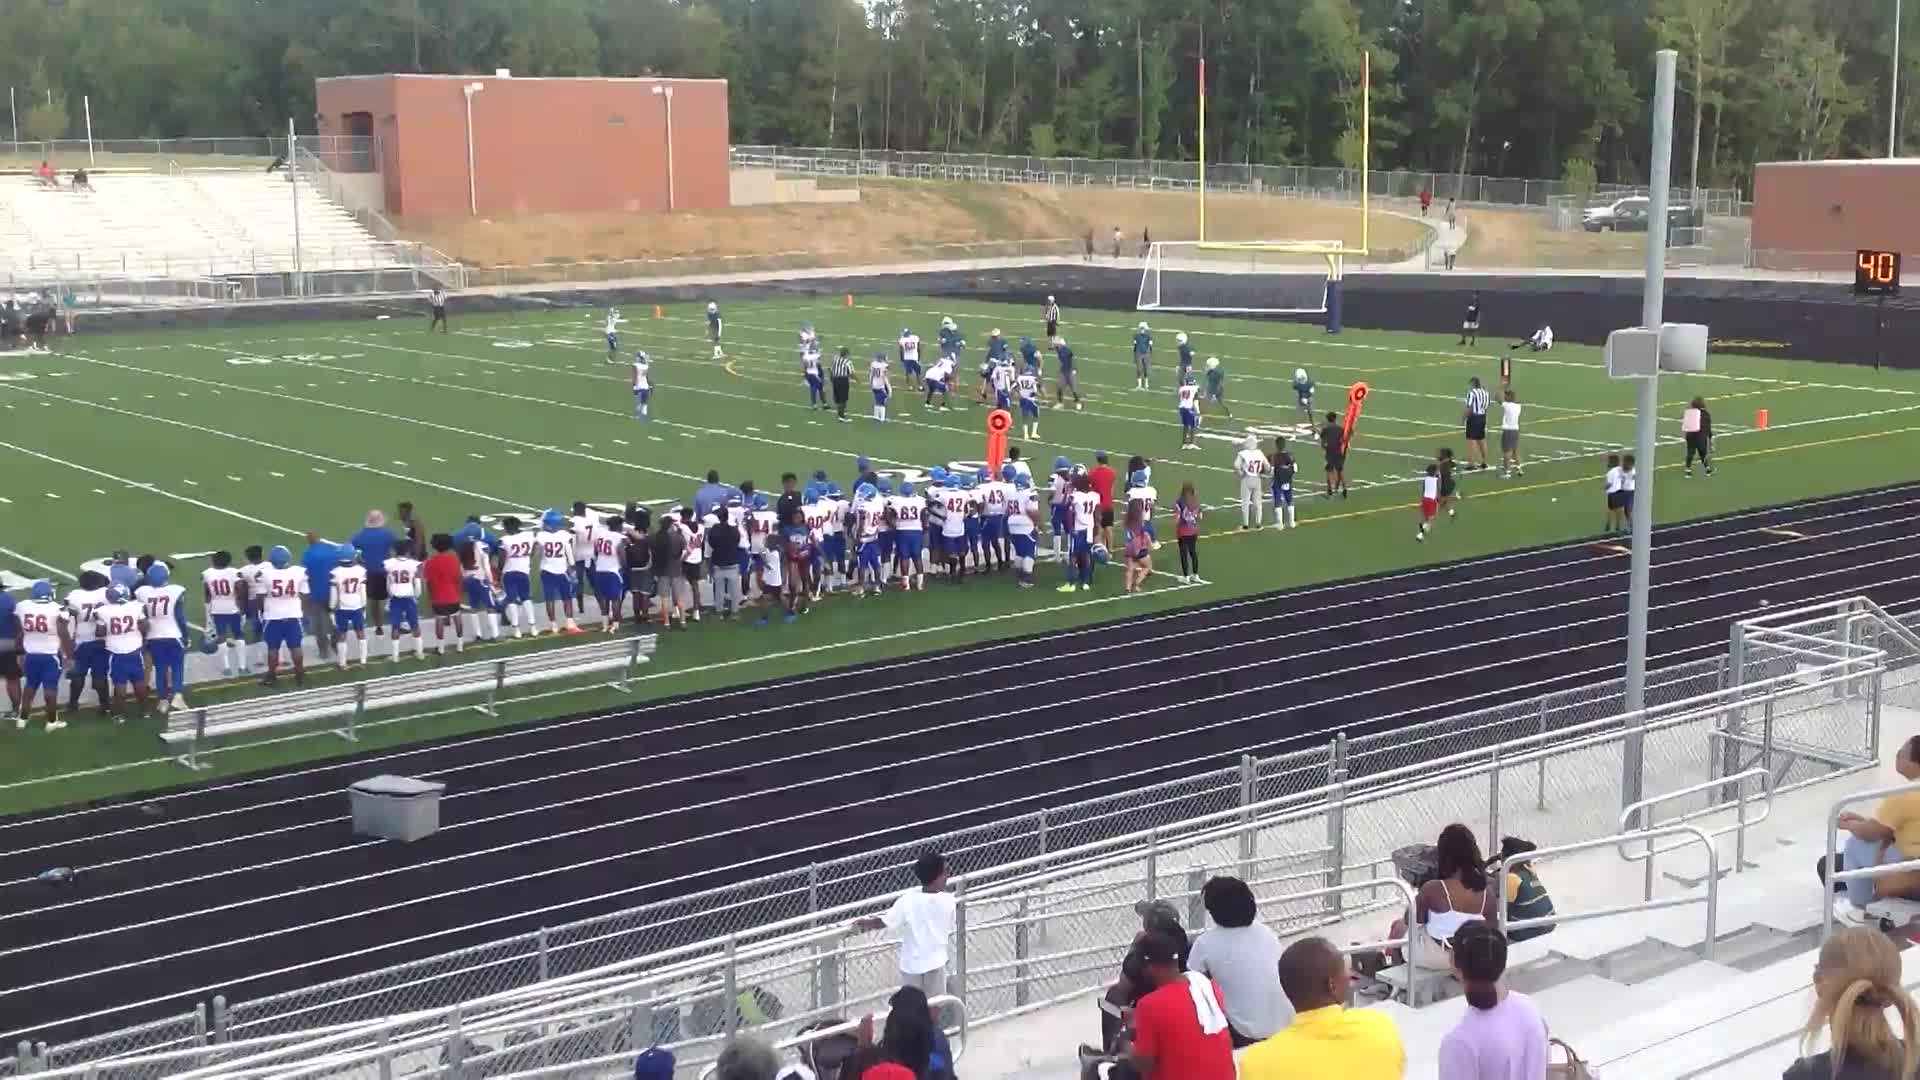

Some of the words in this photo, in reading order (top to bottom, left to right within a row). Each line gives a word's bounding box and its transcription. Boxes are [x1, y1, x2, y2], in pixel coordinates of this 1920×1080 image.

[1859, 253, 1893, 282] 40
[947, 497, 963, 512] 42
[987, 489, 1004, 504] 43
[900, 505, 918, 520] 63
[511, 541, 530, 558] 22
[342, 577, 359, 594] 17
[391, 569, 410, 585] 16
[210, 578, 231, 597] 10
[272, 578, 296, 598] 54
[147, 595, 170, 617] 77
[23, 612, 49, 634] 56
[110, 615, 137, 635] 62
